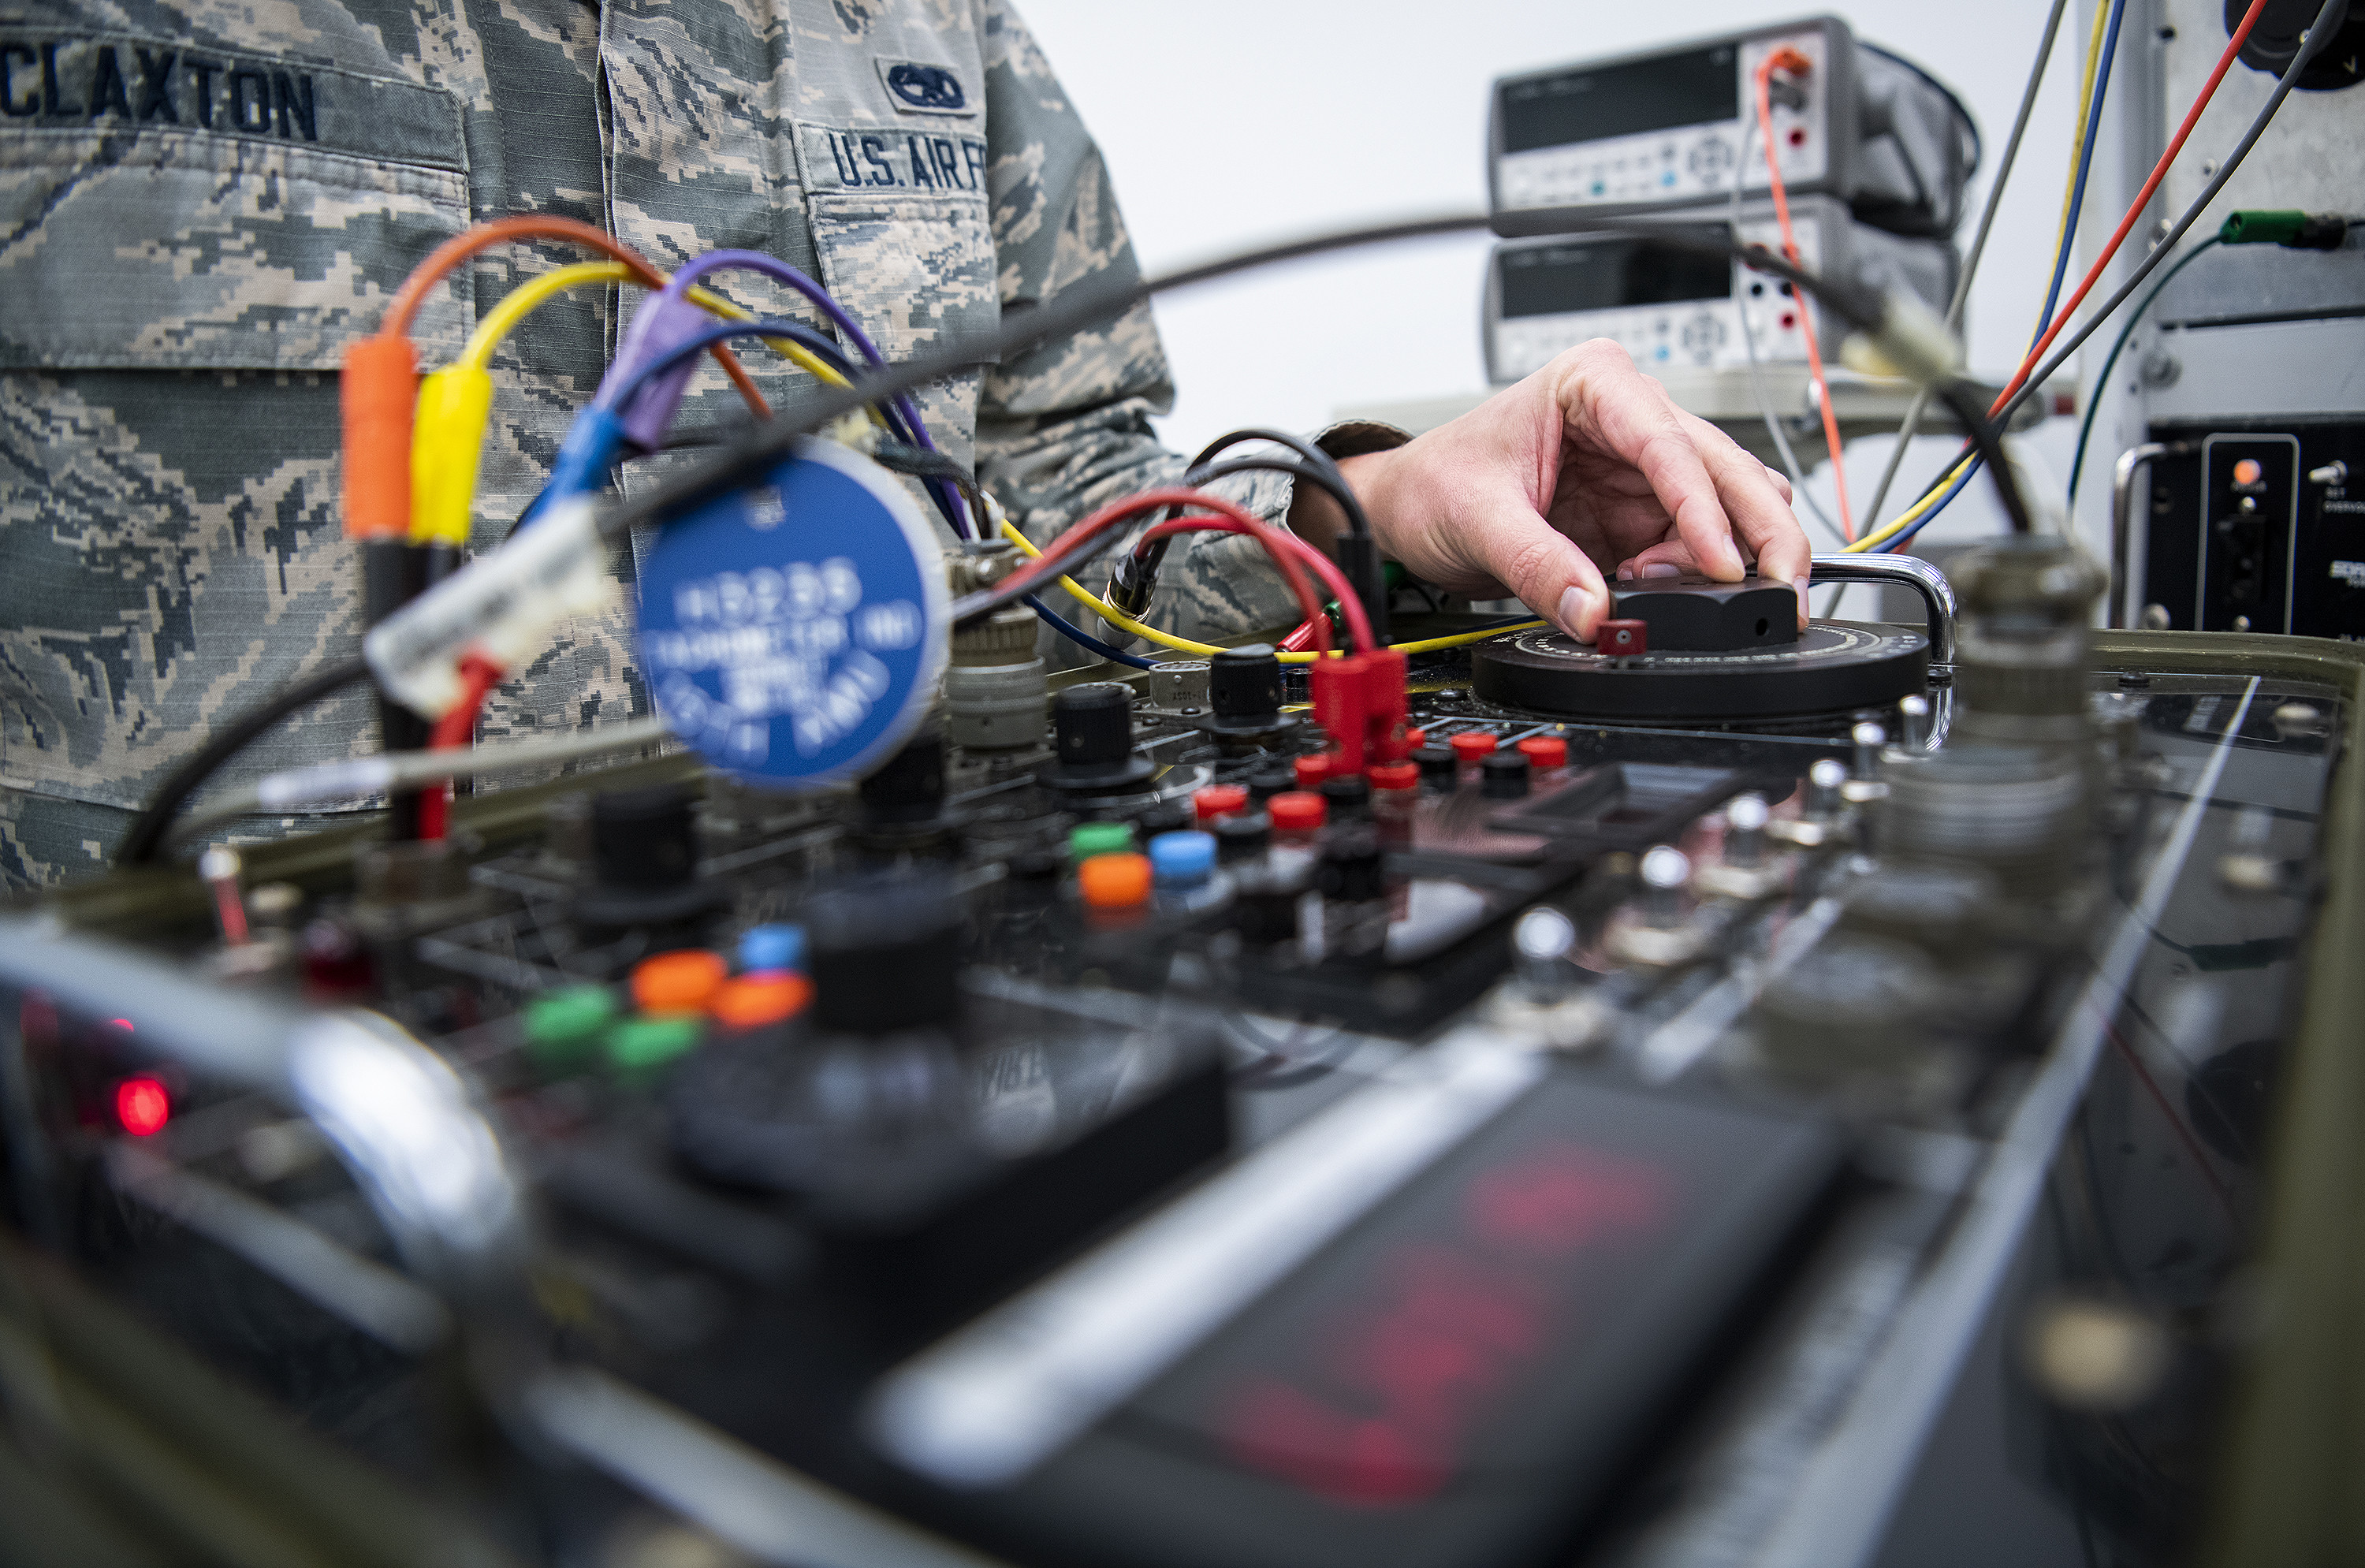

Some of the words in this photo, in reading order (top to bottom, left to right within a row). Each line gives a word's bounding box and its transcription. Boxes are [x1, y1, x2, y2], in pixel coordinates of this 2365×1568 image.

[0, 42, 318, 143] CLAXTON
[829, 132, 907, 188] U.S.
[907, 136, 965, 190] AIR
